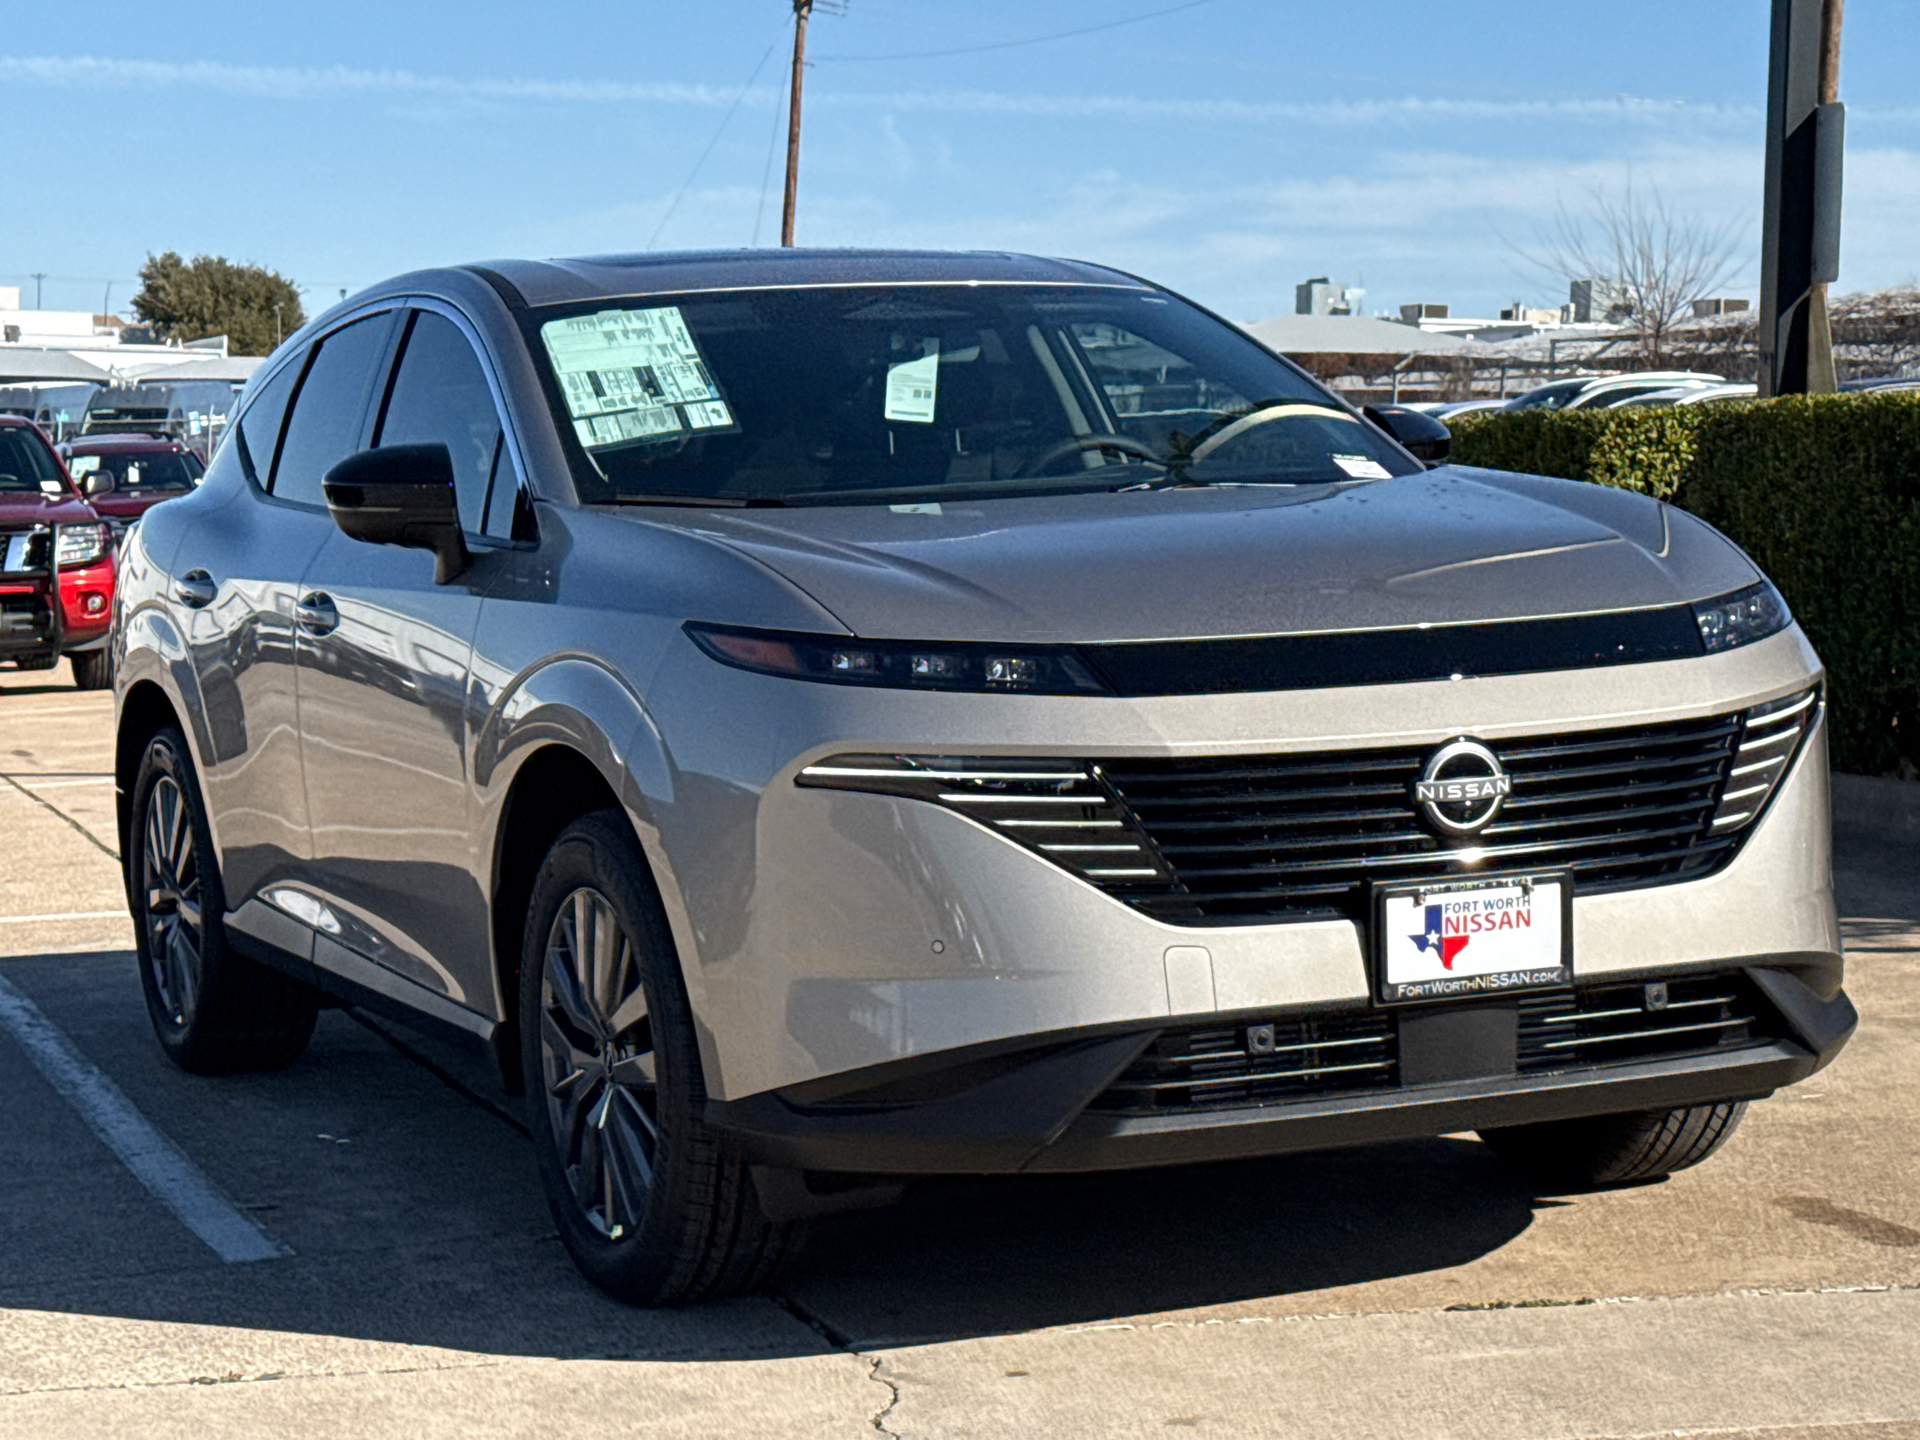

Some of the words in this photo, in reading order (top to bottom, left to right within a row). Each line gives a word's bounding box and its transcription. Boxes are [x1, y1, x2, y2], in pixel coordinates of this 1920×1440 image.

[1418, 778, 1509, 799] NISSAN
[1444, 900, 1479, 914] FORT
[1483, 897, 1531, 910] WORTH
[1445, 909, 1531, 935] NISSAN
